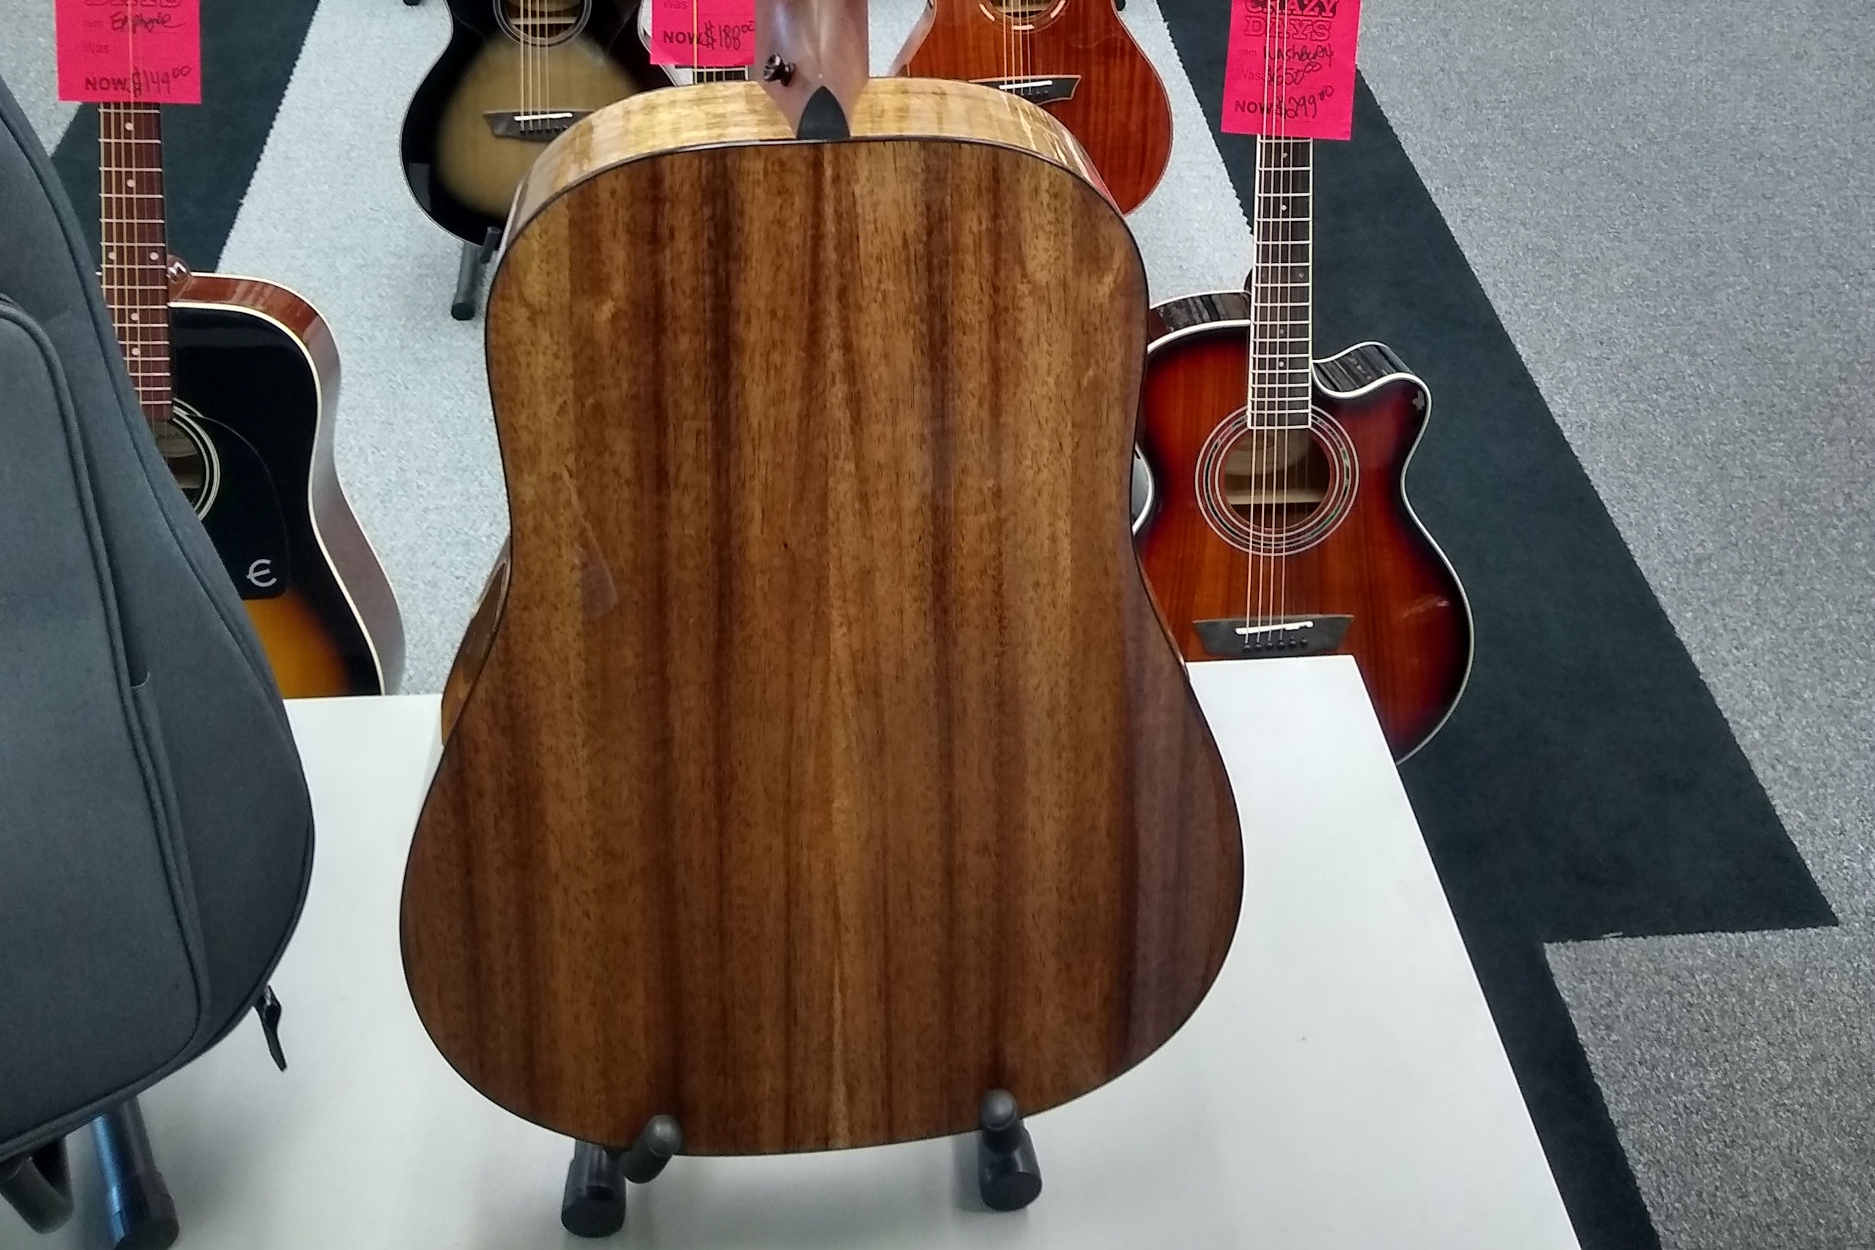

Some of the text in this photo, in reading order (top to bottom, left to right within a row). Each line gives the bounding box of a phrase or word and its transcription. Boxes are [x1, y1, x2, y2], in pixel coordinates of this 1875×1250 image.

[1244, 16, 1334, 42] DAYS
[663, 31, 702, 45] NOW
[85, 77, 128, 92] NOW
[1234, 100, 1273, 115] NOW
